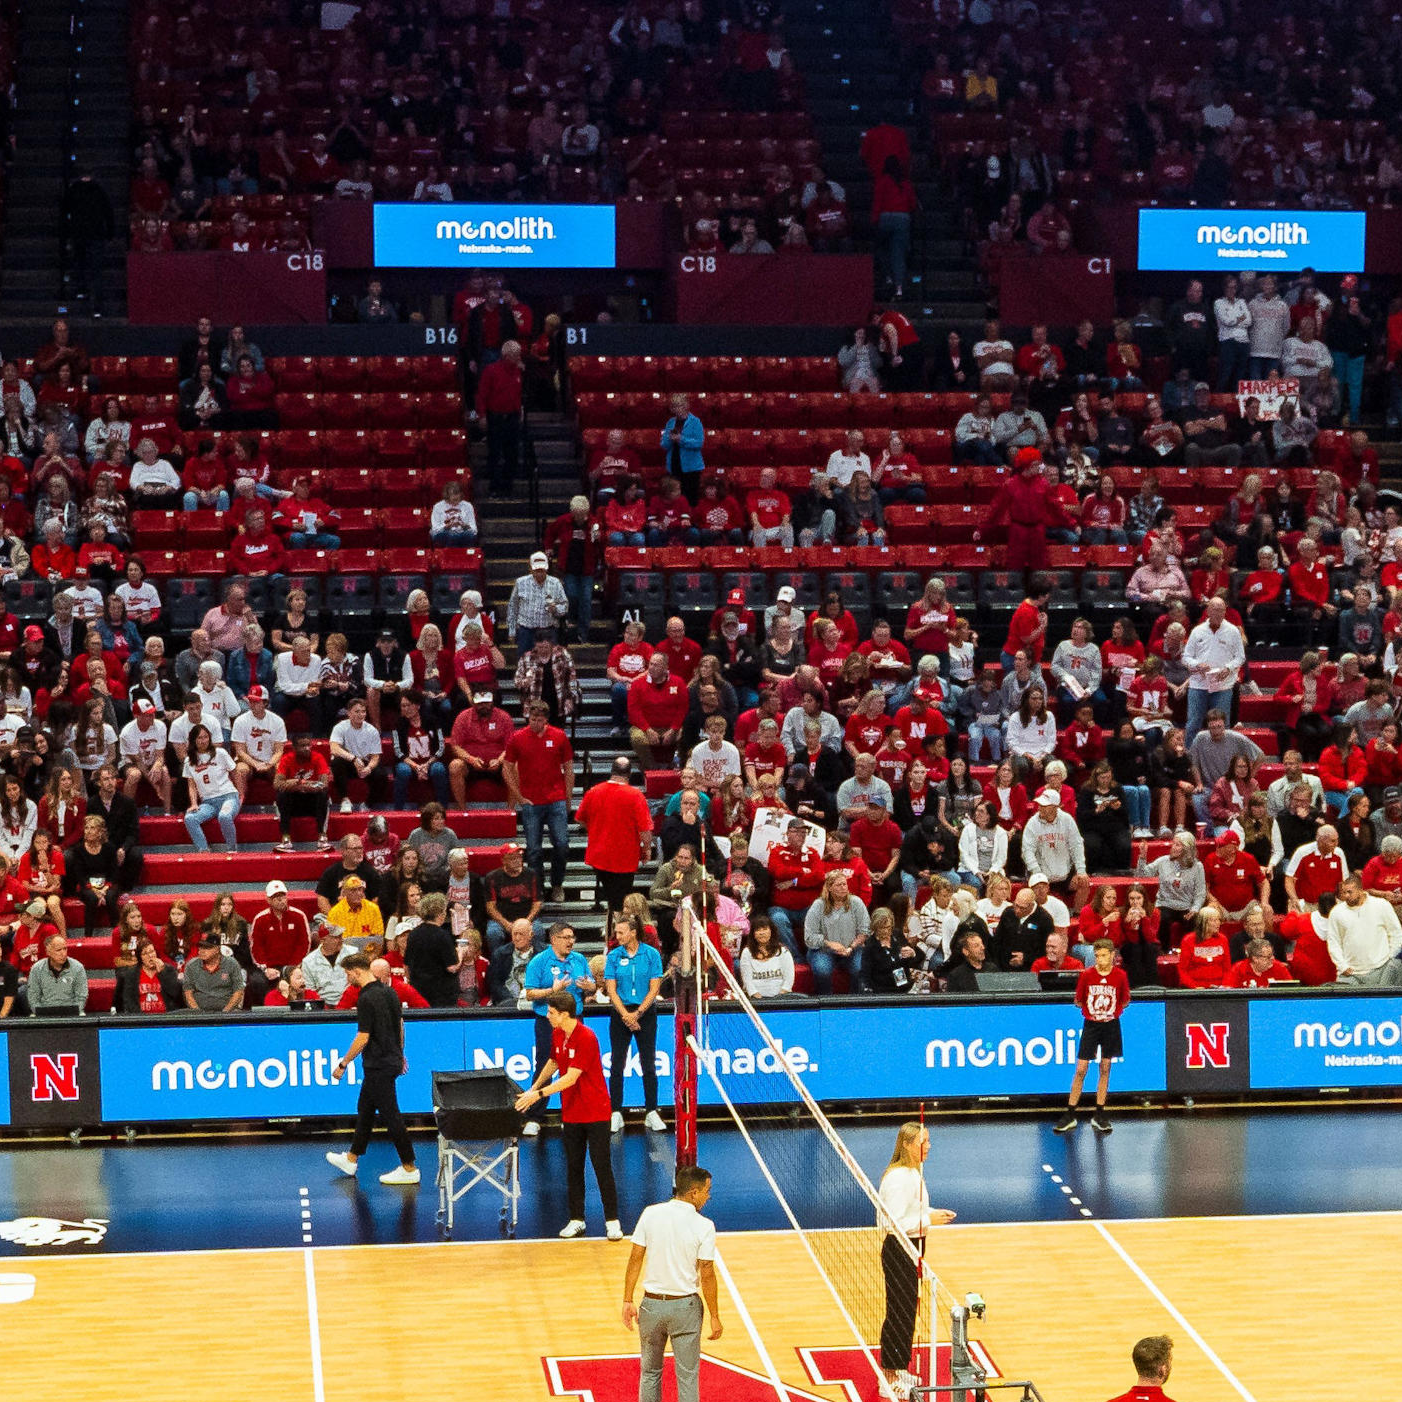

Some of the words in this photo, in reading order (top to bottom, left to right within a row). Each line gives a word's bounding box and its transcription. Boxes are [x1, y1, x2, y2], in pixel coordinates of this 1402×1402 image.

[287, 254, 323, 271] C18
[680, 256, 716, 273] C18
[1088, 258, 1111, 274] C1
[425, 328, 458, 345] B16
[1238, 380, 1298, 396] HARPER
[911, 721, 925, 738] N
[408, 736, 428, 758] N
[1074, 731, 1088, 746] N
[1186, 1023, 1230, 1069] N
[30, 1054, 79, 1101] N
